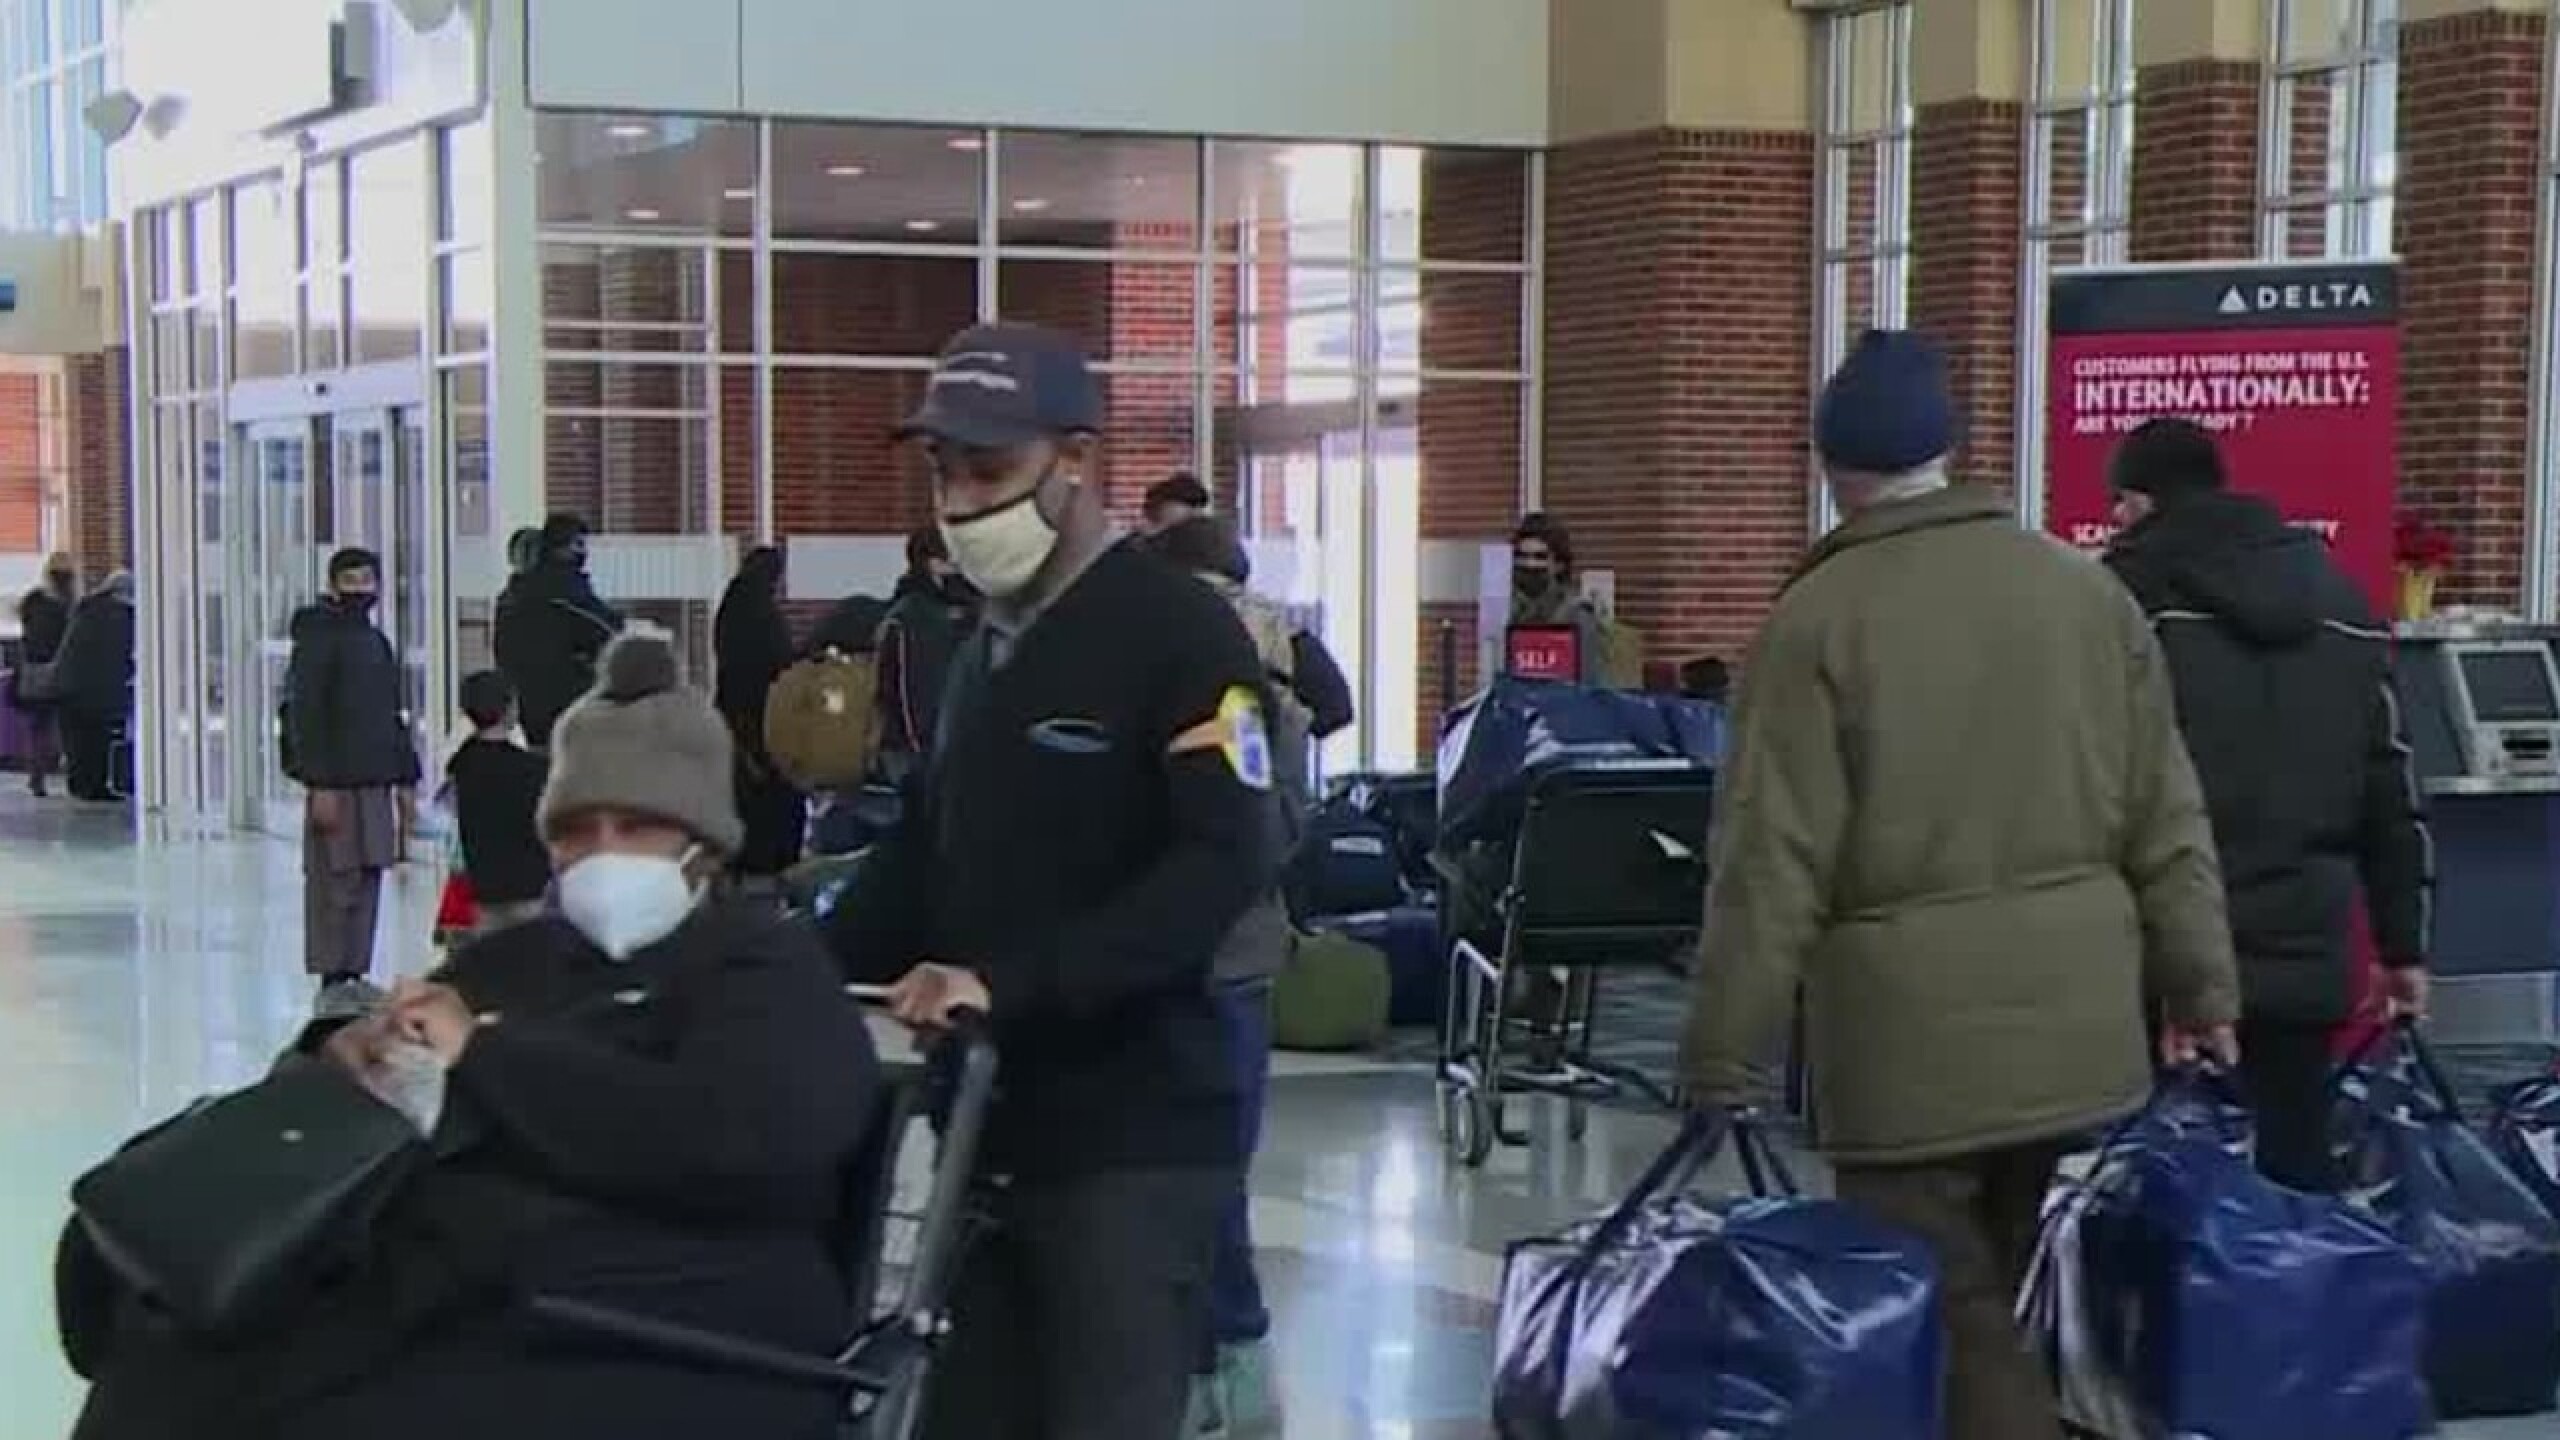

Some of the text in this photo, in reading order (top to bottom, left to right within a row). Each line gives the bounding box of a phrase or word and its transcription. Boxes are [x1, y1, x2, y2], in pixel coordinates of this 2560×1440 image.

[2256, 284, 2371, 309] DELTA
[2074, 356, 2176, 376] CUSTOMERS
[2179, 353, 2241, 373] FLYING
[2244, 352, 2295, 372] FROM
[2300, 351, 2332, 369] THE
[2074, 373, 2370, 411] INTERNATIONALLY:
[2073, 414, 2106, 433] ARE
